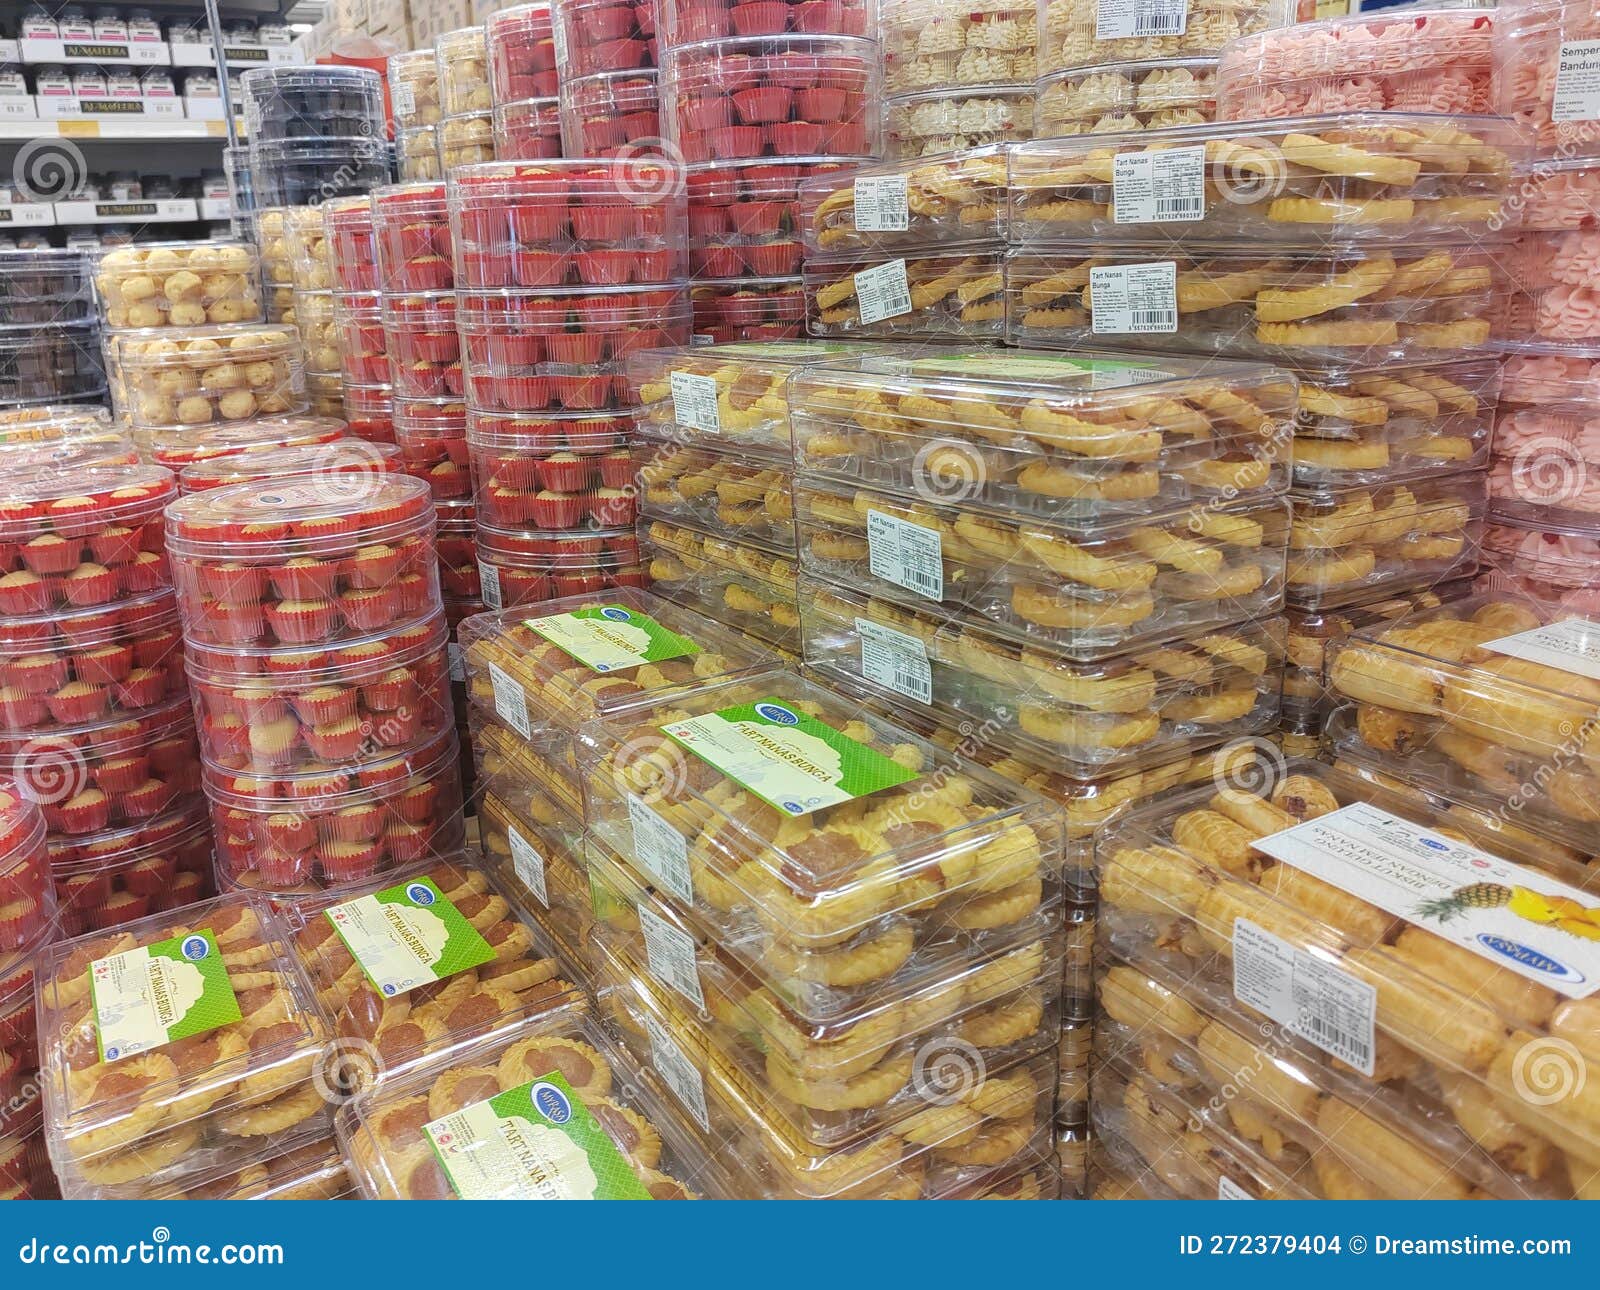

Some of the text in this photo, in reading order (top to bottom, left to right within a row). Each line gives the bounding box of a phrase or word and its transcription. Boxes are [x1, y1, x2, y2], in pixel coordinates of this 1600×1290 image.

[1560, 60, 1600, 71] Bandun
[1115, 169, 1135, 177] Bunga
[1092, 282, 1111, 290] Bunga
[733, 723, 763, 739] TART
[760, 738, 796, 760] NANAS
[791, 757, 832, 782] BUNGA
[409, 939, 433, 964] BUNGA
[500, 1120, 527, 1150] TART
